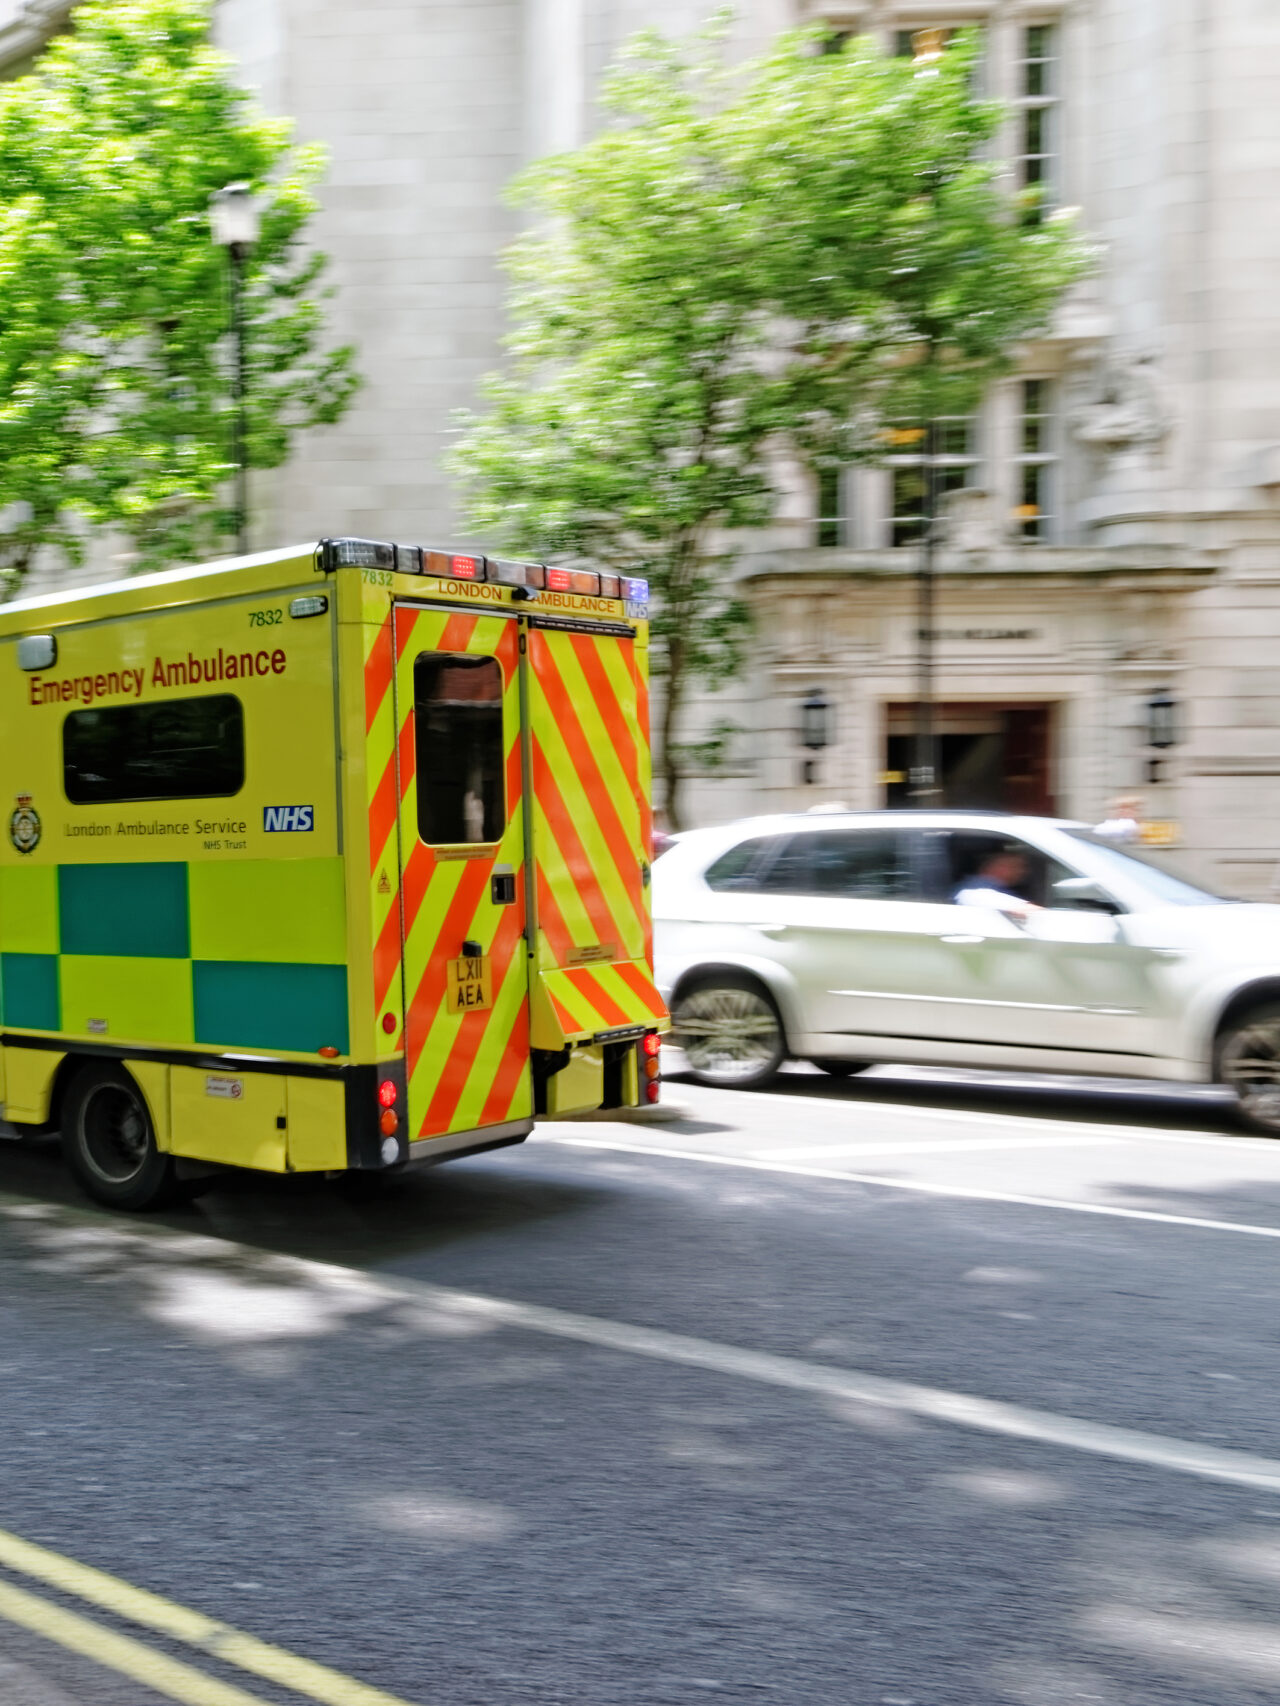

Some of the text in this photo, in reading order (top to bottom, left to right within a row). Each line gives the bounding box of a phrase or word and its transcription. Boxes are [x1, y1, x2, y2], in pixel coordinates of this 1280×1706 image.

[362, 569, 393, 587] 7832
[438, 580, 502, 600] LONDON
[248, 609, 283, 627] 7832
[627, 601, 647, 618] NHS
[29, 648, 287, 705] Emergency Ambulance
[64, 817, 247, 837] London Ambulance Service
[265, 806, 312, 831] NHS
[204, 839, 247, 850] NHS Trust
[457, 983, 484, 1007] AEA
